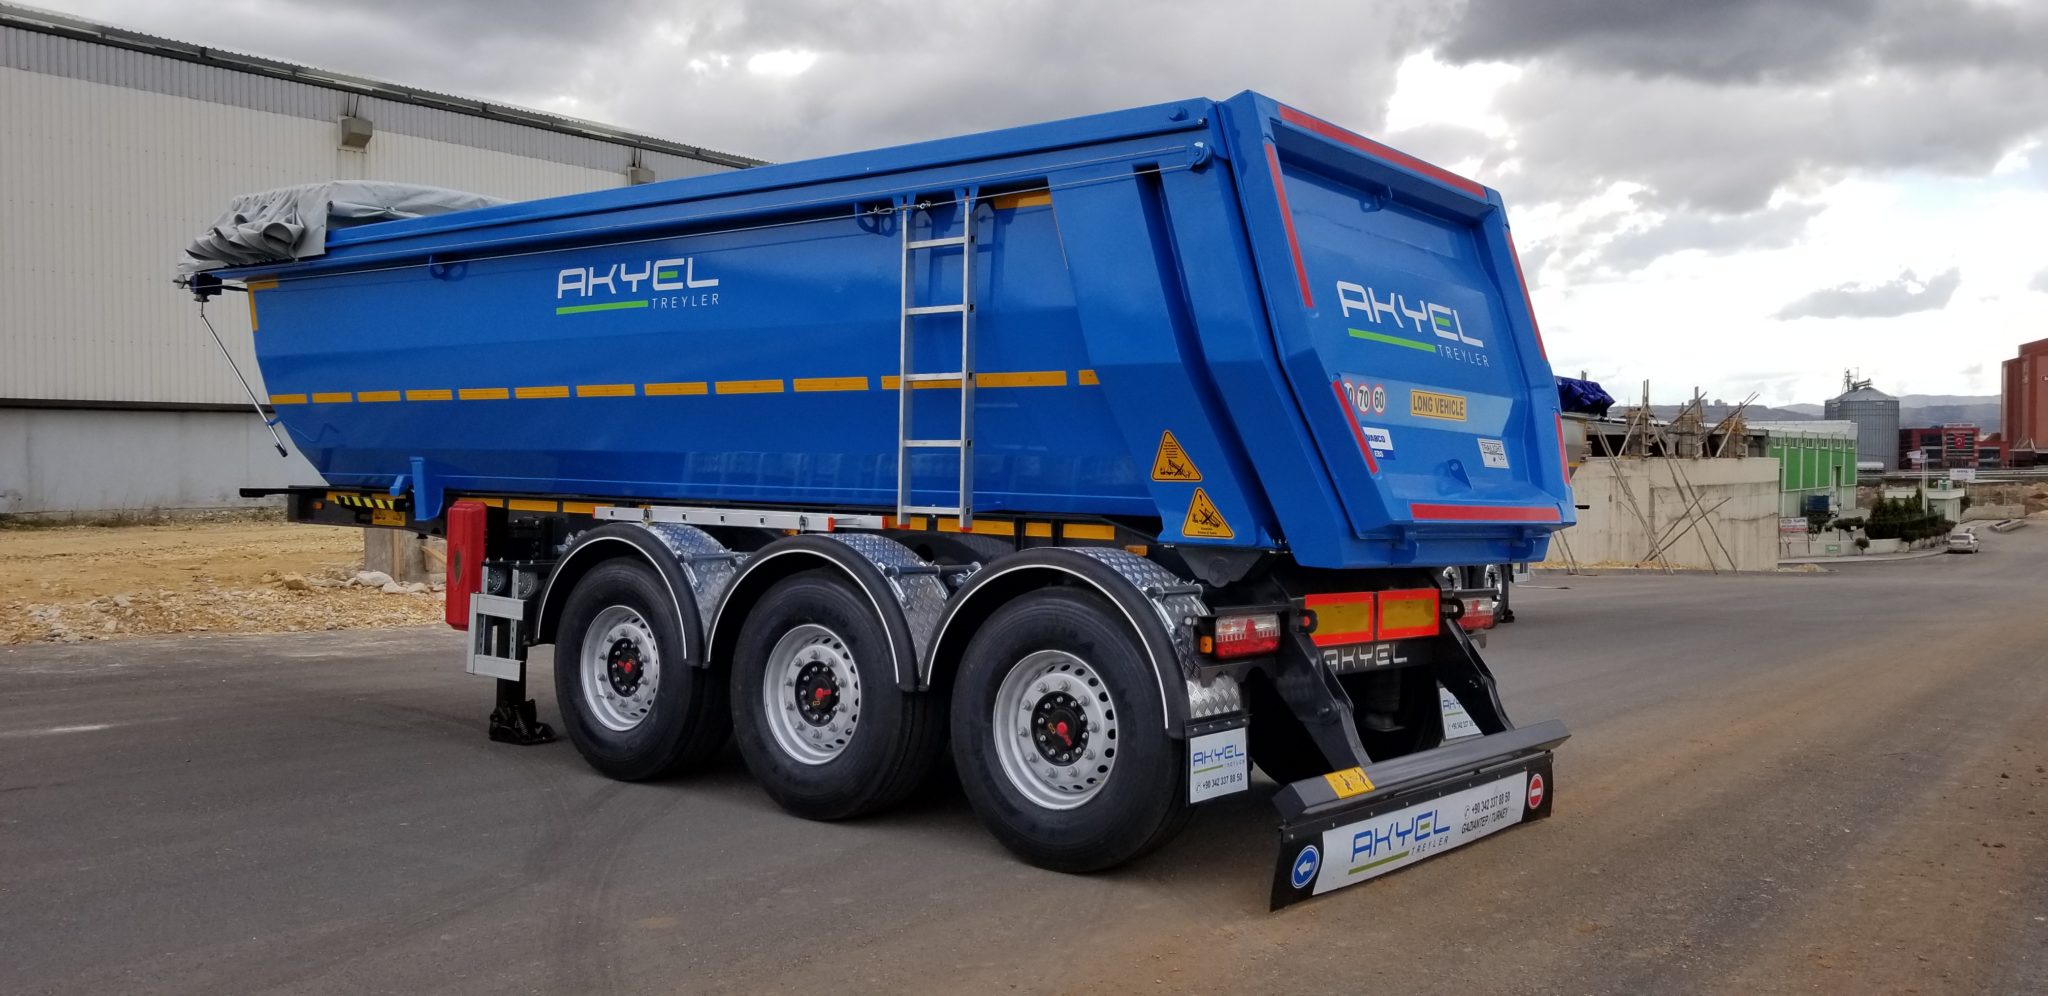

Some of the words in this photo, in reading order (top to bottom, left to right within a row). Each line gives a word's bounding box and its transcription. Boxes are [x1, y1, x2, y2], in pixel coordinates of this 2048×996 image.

[557, 257, 719, 299] AKYEL
[652, 293, 719, 310] TREYLER
[1336, 280, 1484, 348] AKYEL
[1437, 344, 1490, 368] TREYLER
[1359, 389, 1369, 408] 70
[1374, 390, 1384, 409] 60
[1412, 394, 1433, 413] LONG
[1434, 398, 1464, 417] VEHICLE
[1324, 643, 1408, 671] AKYEL
[1193, 744, 1245, 767] AKYEL
[1351, 809, 1451, 863] AKYEL
[1411, 835, 1449, 855] TREYLER
